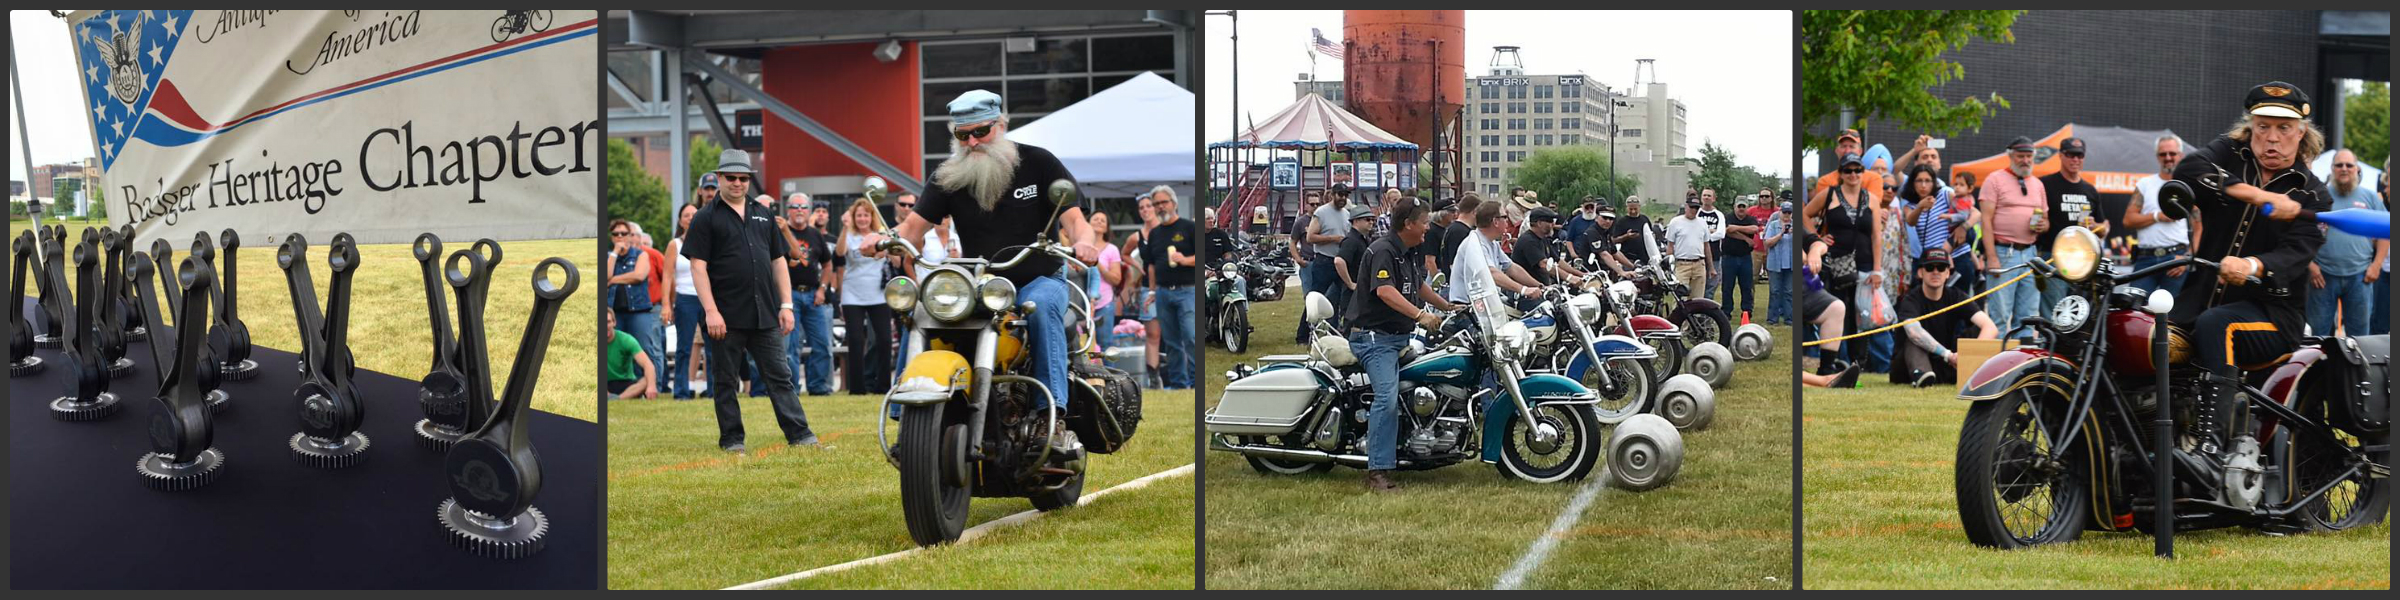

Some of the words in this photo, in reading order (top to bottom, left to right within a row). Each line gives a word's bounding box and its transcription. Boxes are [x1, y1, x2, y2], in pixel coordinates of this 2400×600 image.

[286, 10, 420, 75] America
[1503, 78, 1529, 86] BRIX
[121, 177, 201, 226] Badger
[208, 149, 344, 215] Heritage
[359, 120, 598, 204] Chapter
[2096, 174, 2138, 190] HARLE
